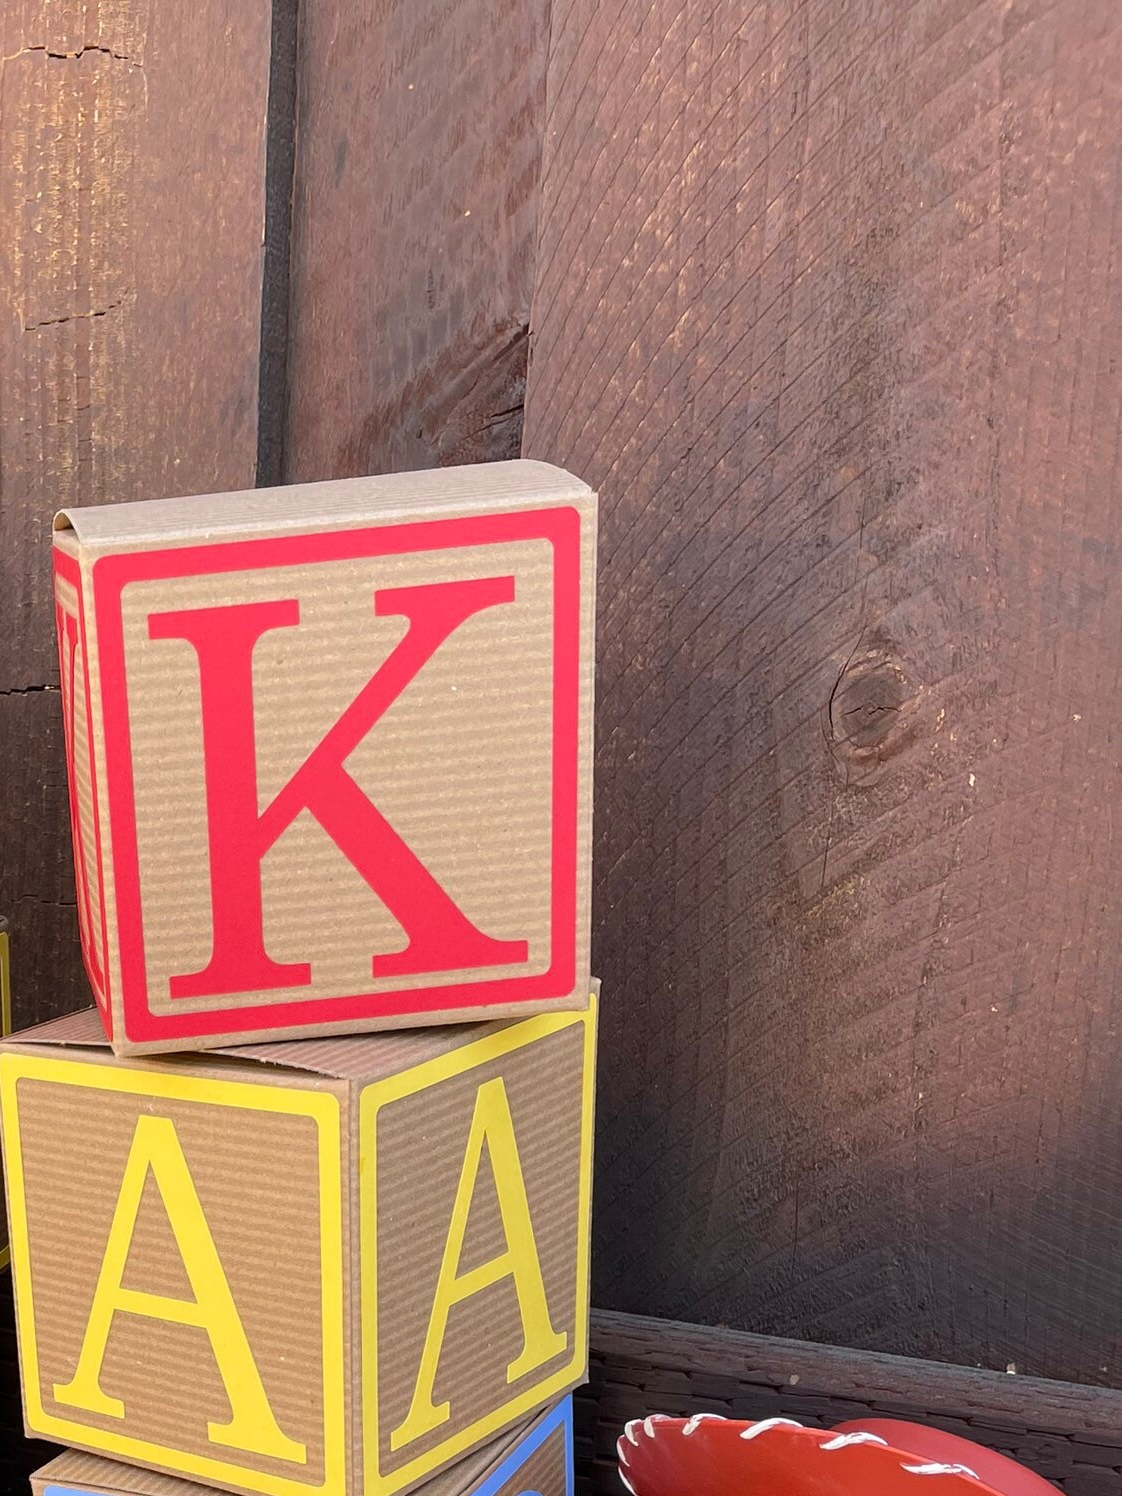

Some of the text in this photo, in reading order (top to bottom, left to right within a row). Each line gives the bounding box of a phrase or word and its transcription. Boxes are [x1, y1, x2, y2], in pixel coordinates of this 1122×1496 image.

[147, 575, 528, 999] K
[52, 1114, 307, 1464] A
[390, 1076, 568, 1452] A
